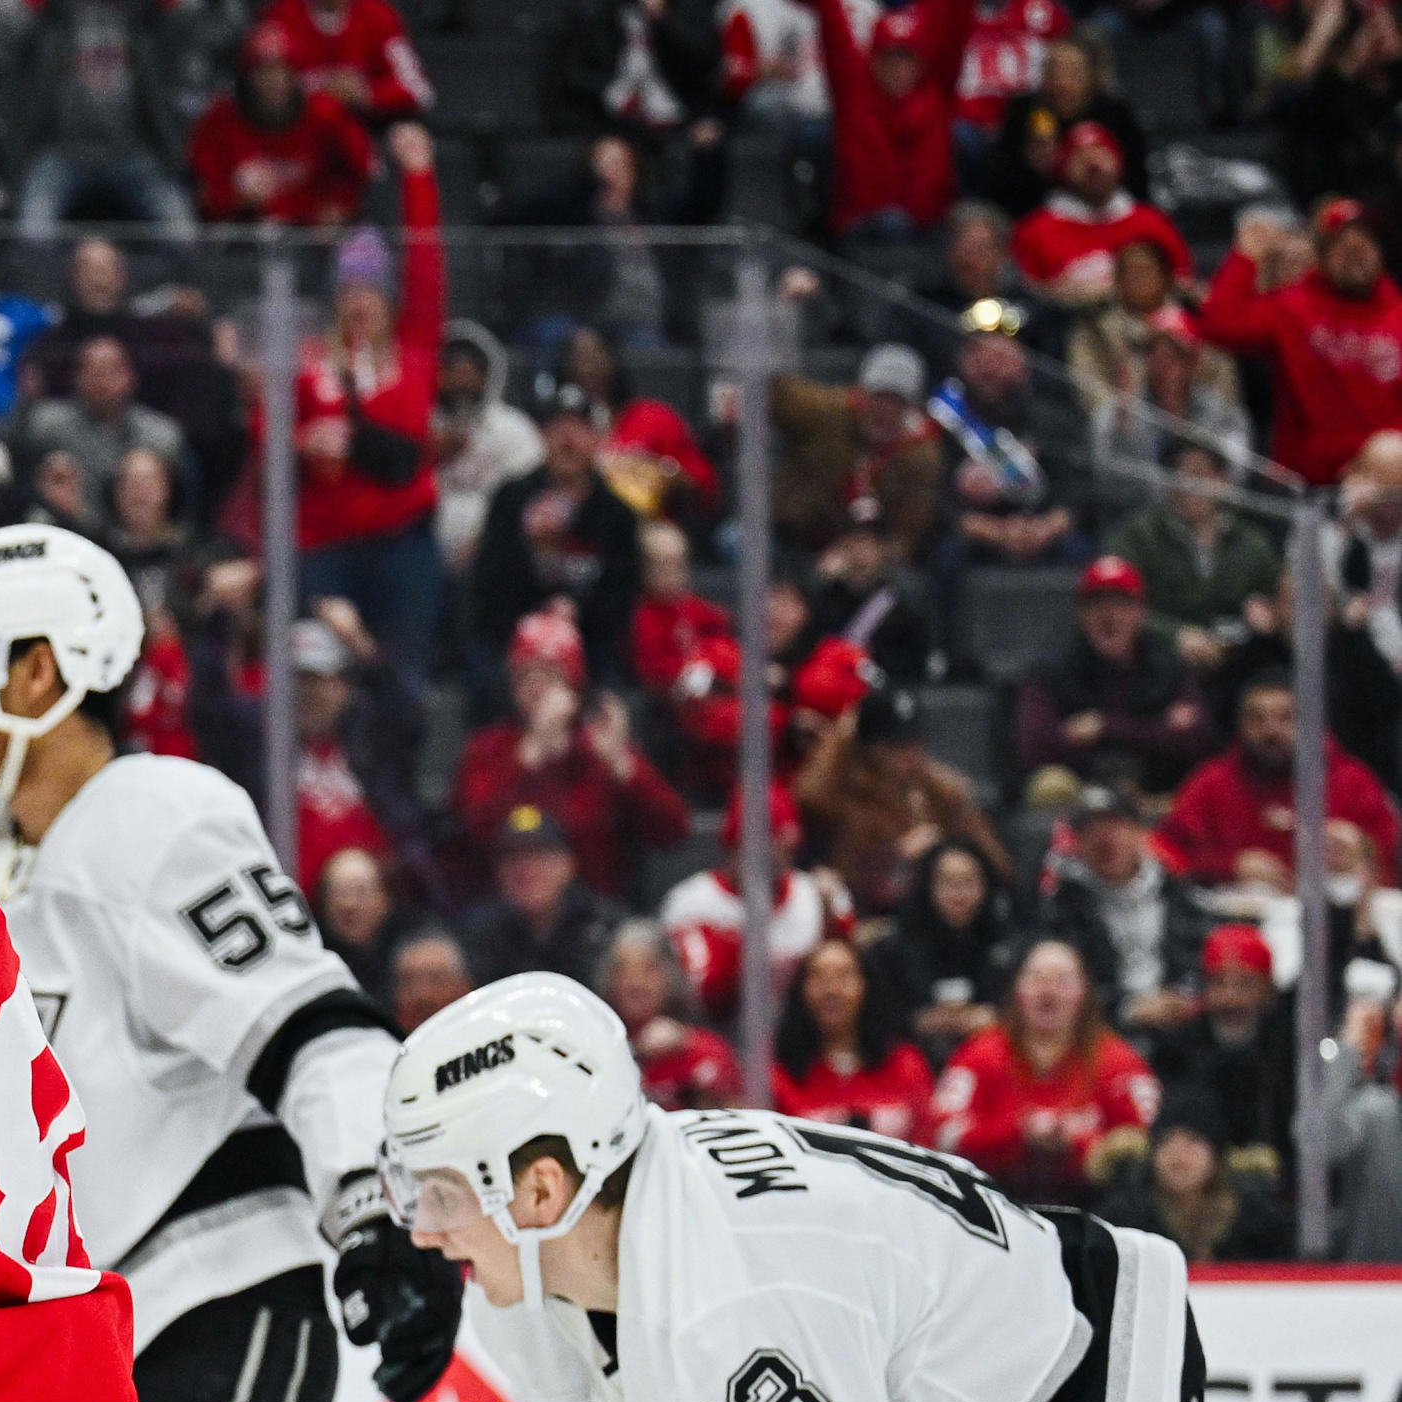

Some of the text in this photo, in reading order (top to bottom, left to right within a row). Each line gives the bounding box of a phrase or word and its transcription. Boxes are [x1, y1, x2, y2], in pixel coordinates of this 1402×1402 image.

[173, 864, 309, 973] 55
[435, 1033, 516, 1094] KINGS
[774, 1120, 1011, 1251] 4
